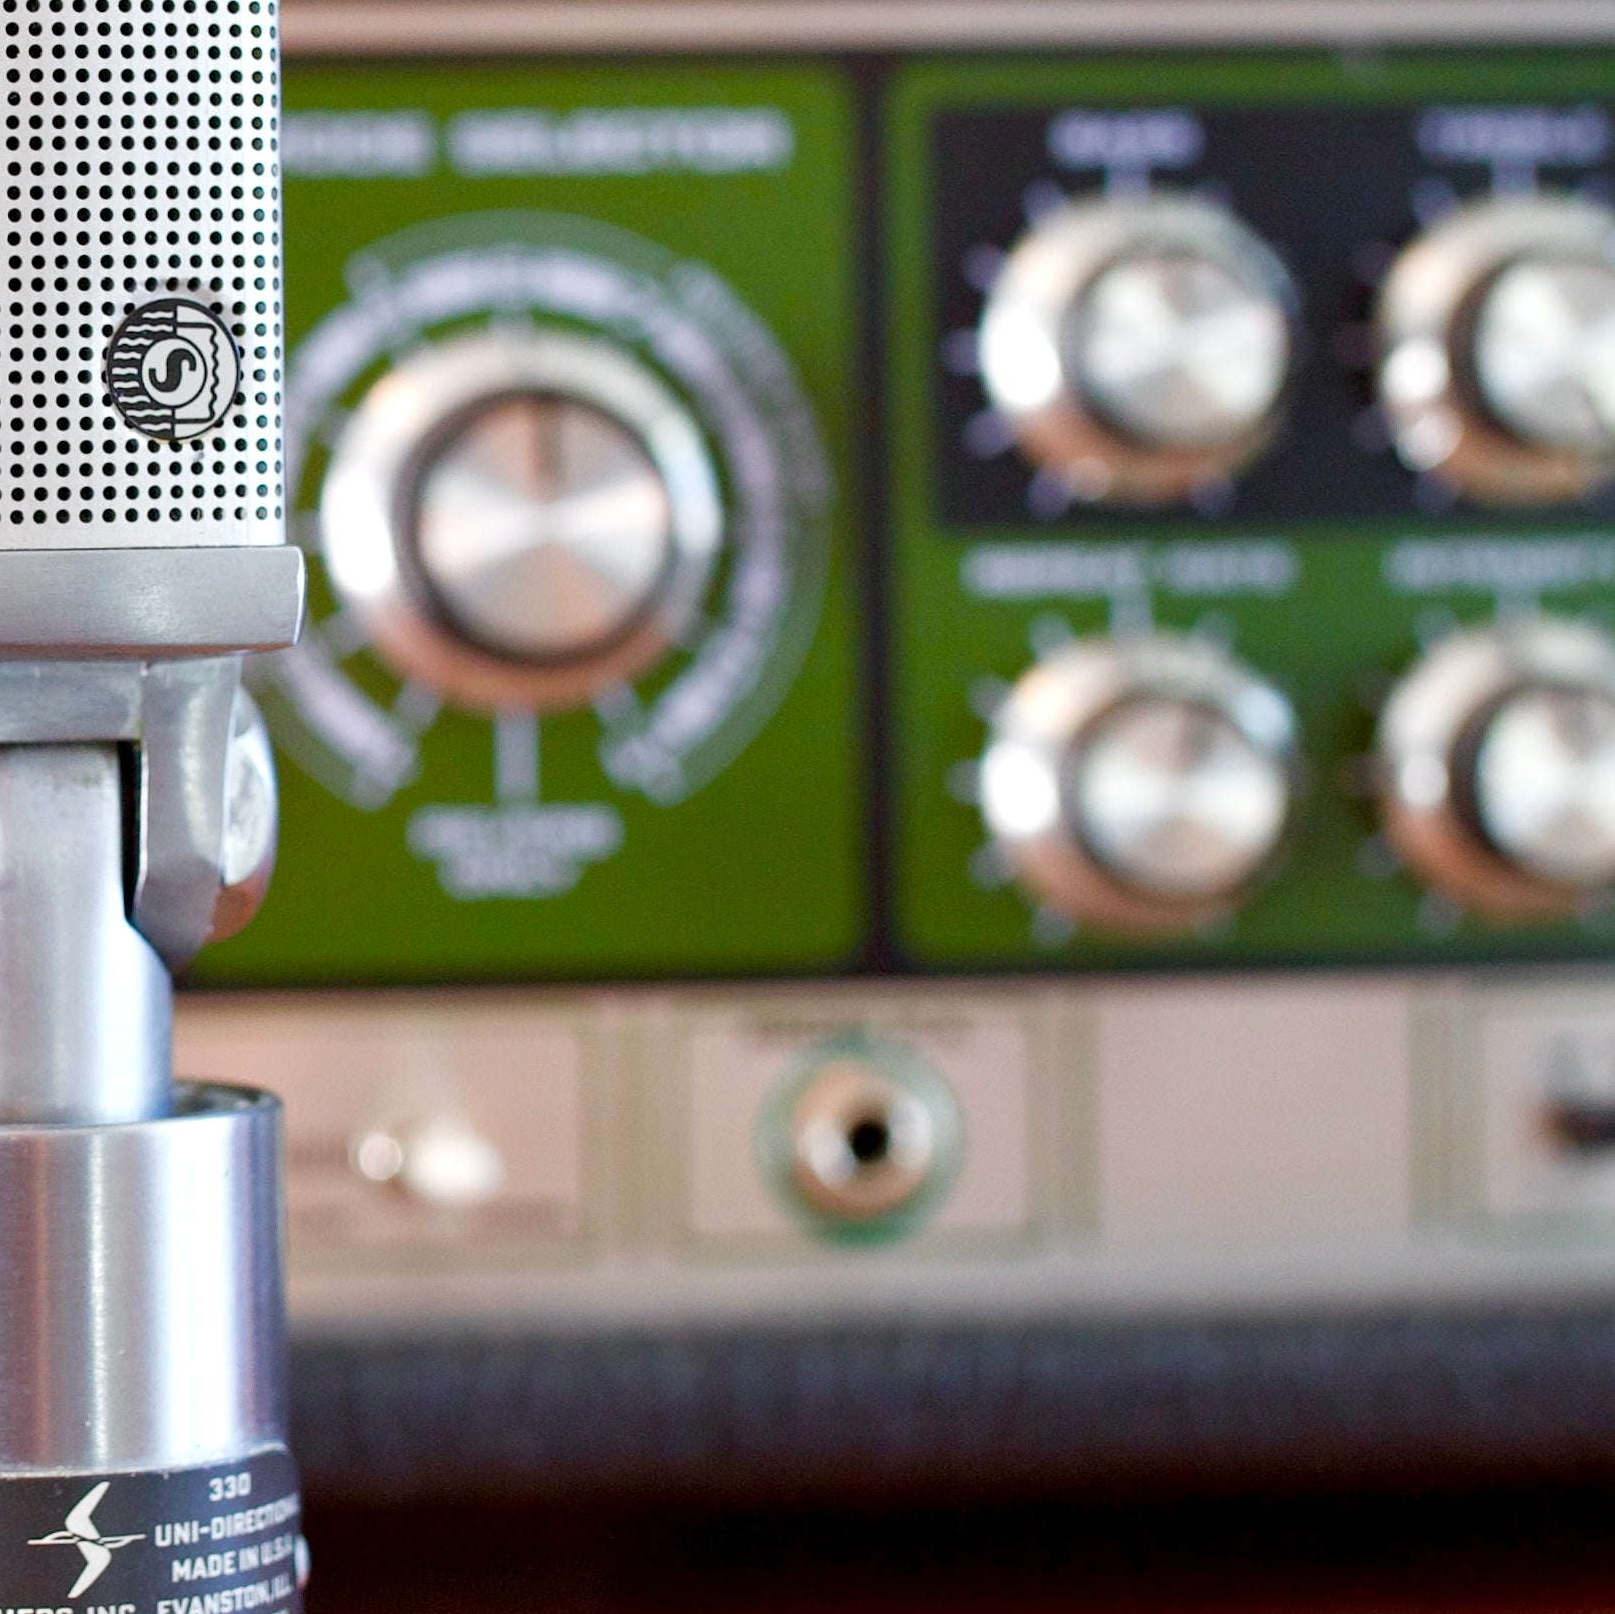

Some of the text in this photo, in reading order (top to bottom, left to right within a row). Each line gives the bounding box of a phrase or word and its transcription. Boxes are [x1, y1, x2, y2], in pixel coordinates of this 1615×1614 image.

[208, 1471, 253, 1502] 330
[171, 1550, 237, 1583] MADE
[239, 1544, 260, 1573] IN
